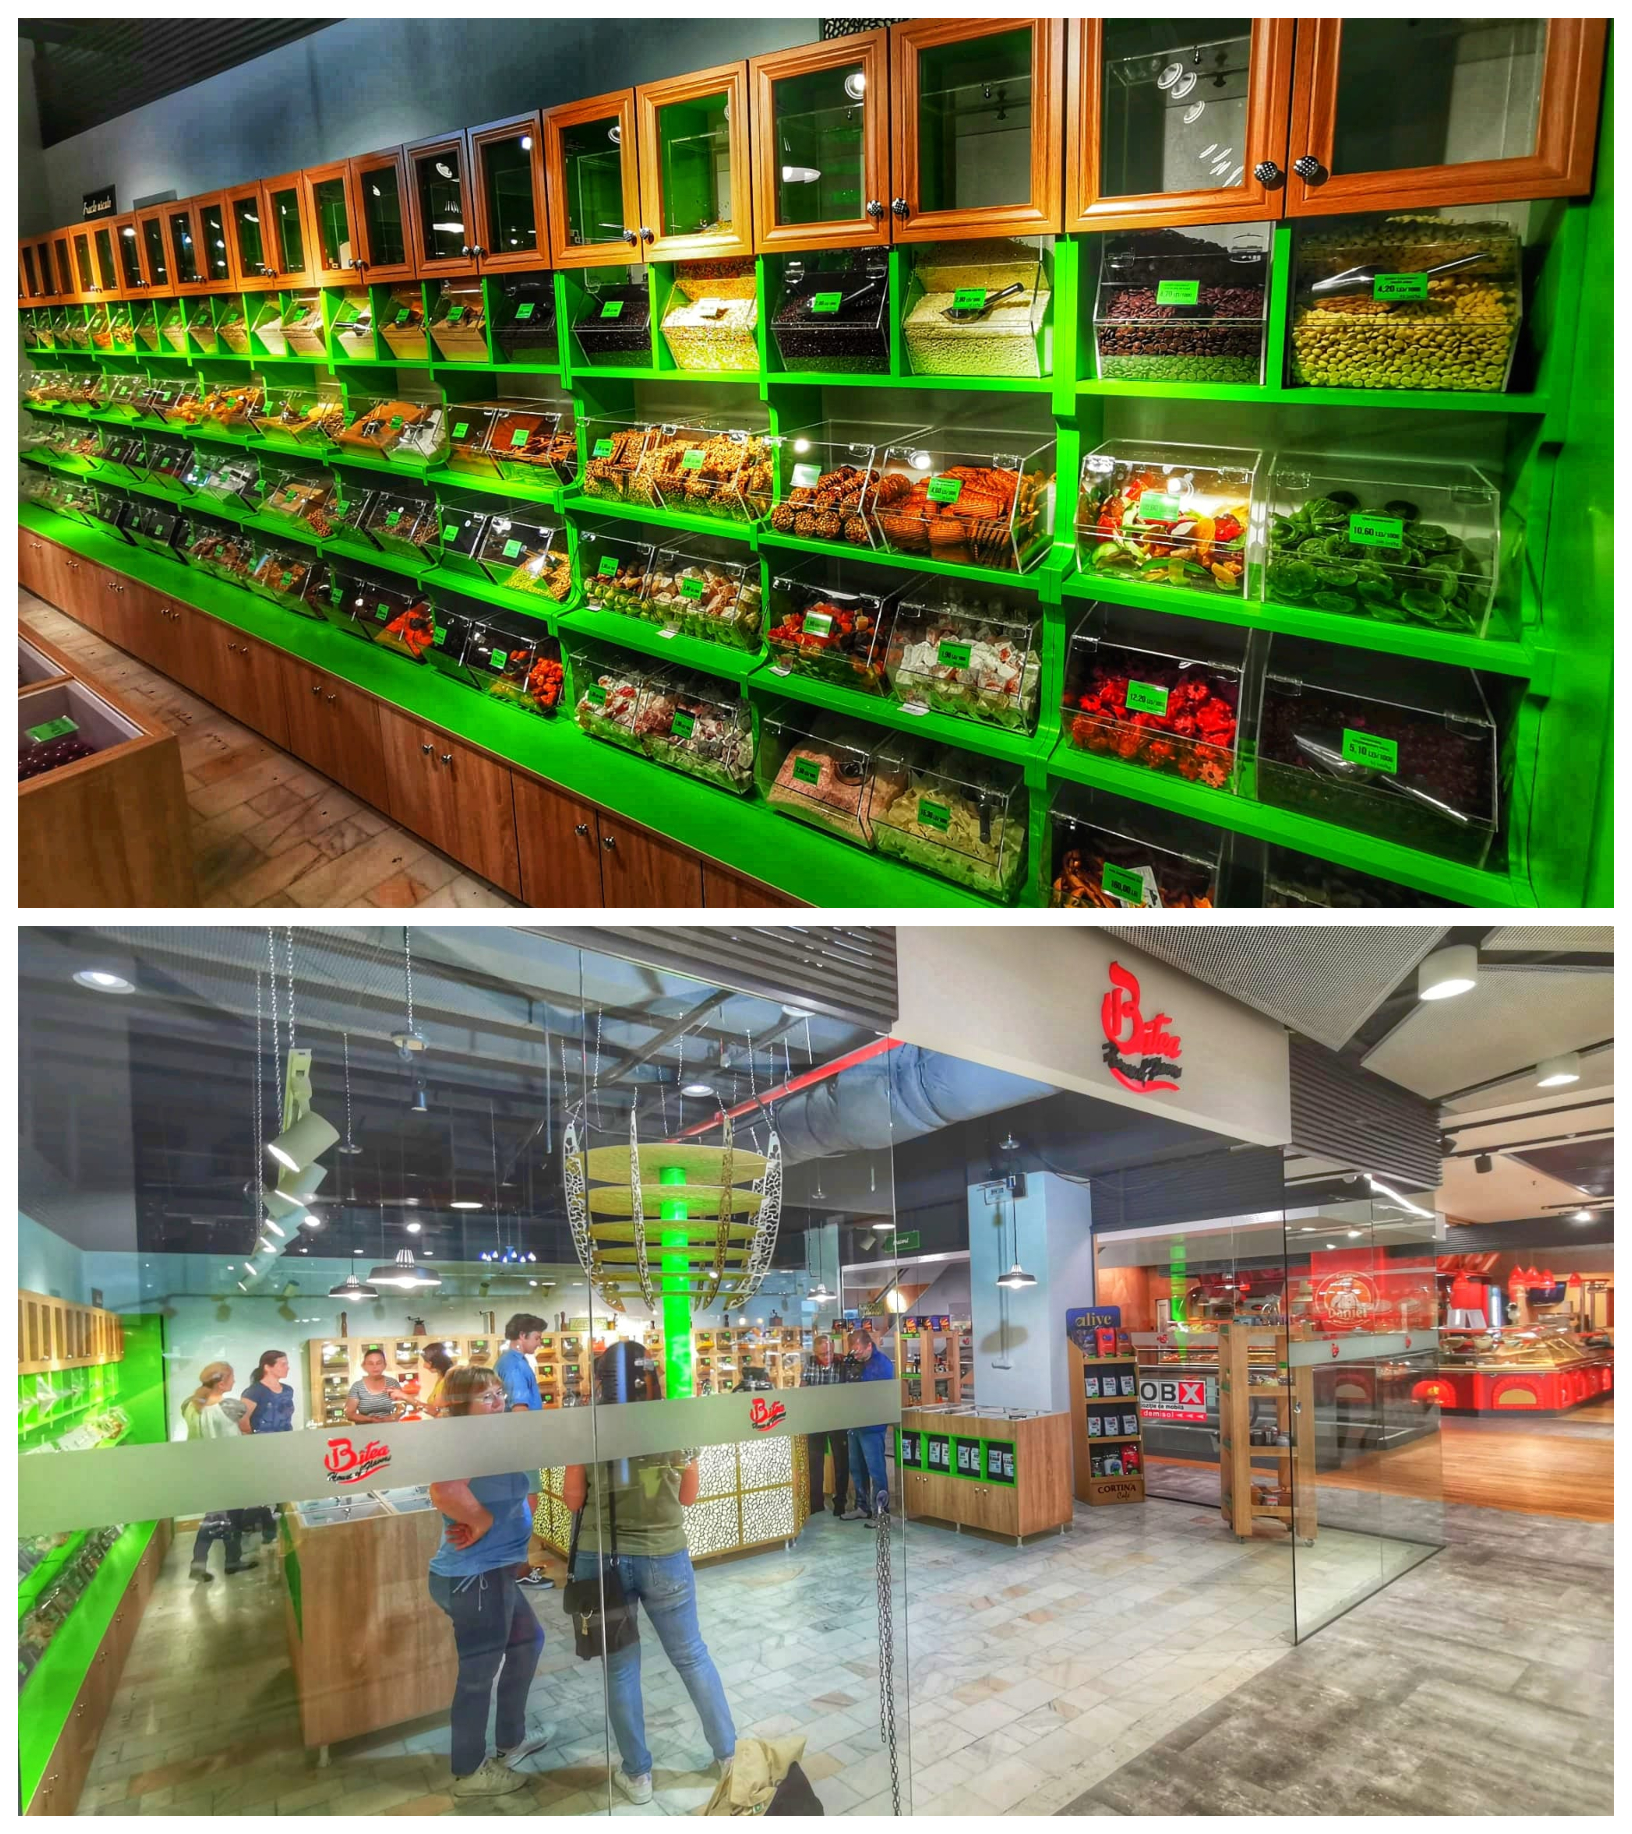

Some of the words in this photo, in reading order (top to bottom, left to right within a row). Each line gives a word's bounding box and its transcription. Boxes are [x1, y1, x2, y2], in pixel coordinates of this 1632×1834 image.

[1353, 526, 1374, 535] 10,60
[1328, 1307, 1368, 1319] Daniel
[1075, 1312, 1112, 1327] alive
[1097, 1482, 1137, 1494] CORTINA
